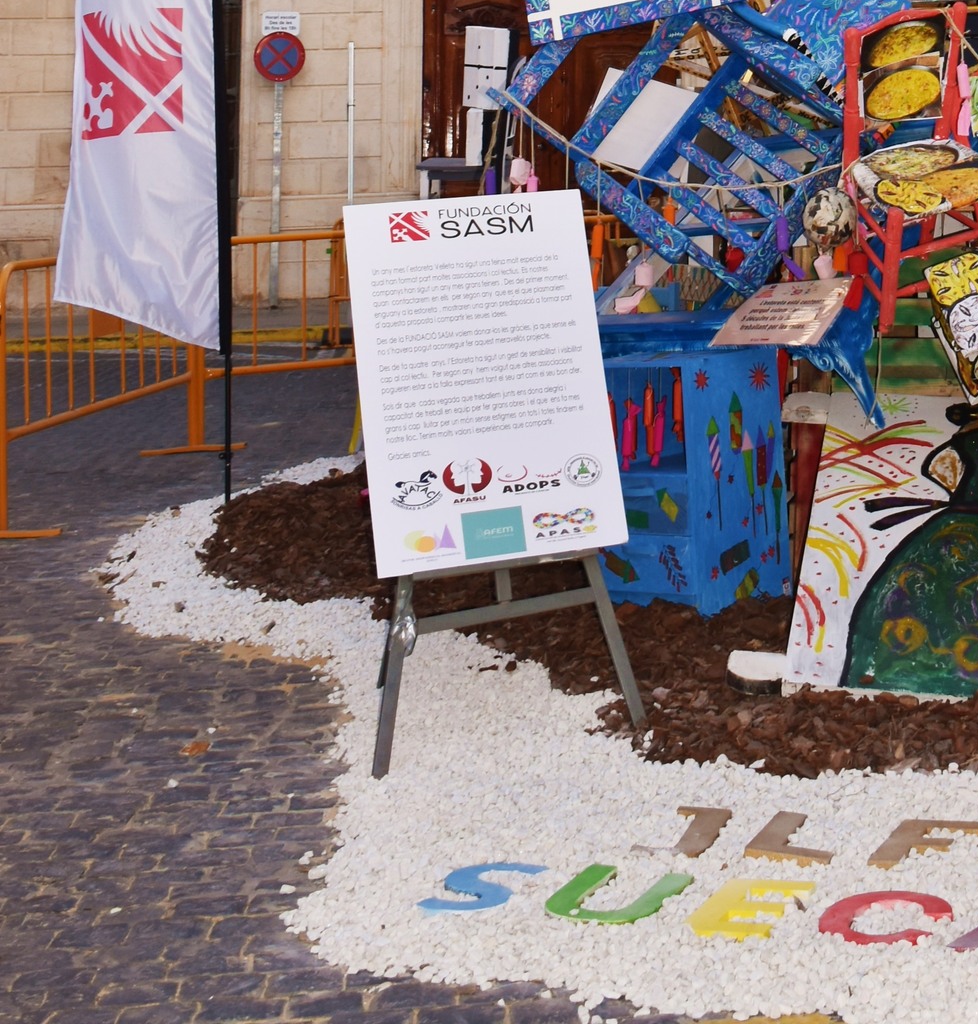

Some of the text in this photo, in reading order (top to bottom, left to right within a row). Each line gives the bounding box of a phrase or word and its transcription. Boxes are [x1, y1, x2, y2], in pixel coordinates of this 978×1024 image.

[438, 202, 531, 220] FUNDACIÓN
[440, 214, 534, 239] SASM
[502, 478, 561, 494] ADOPS
[453, 495, 487, 504] AFASU
